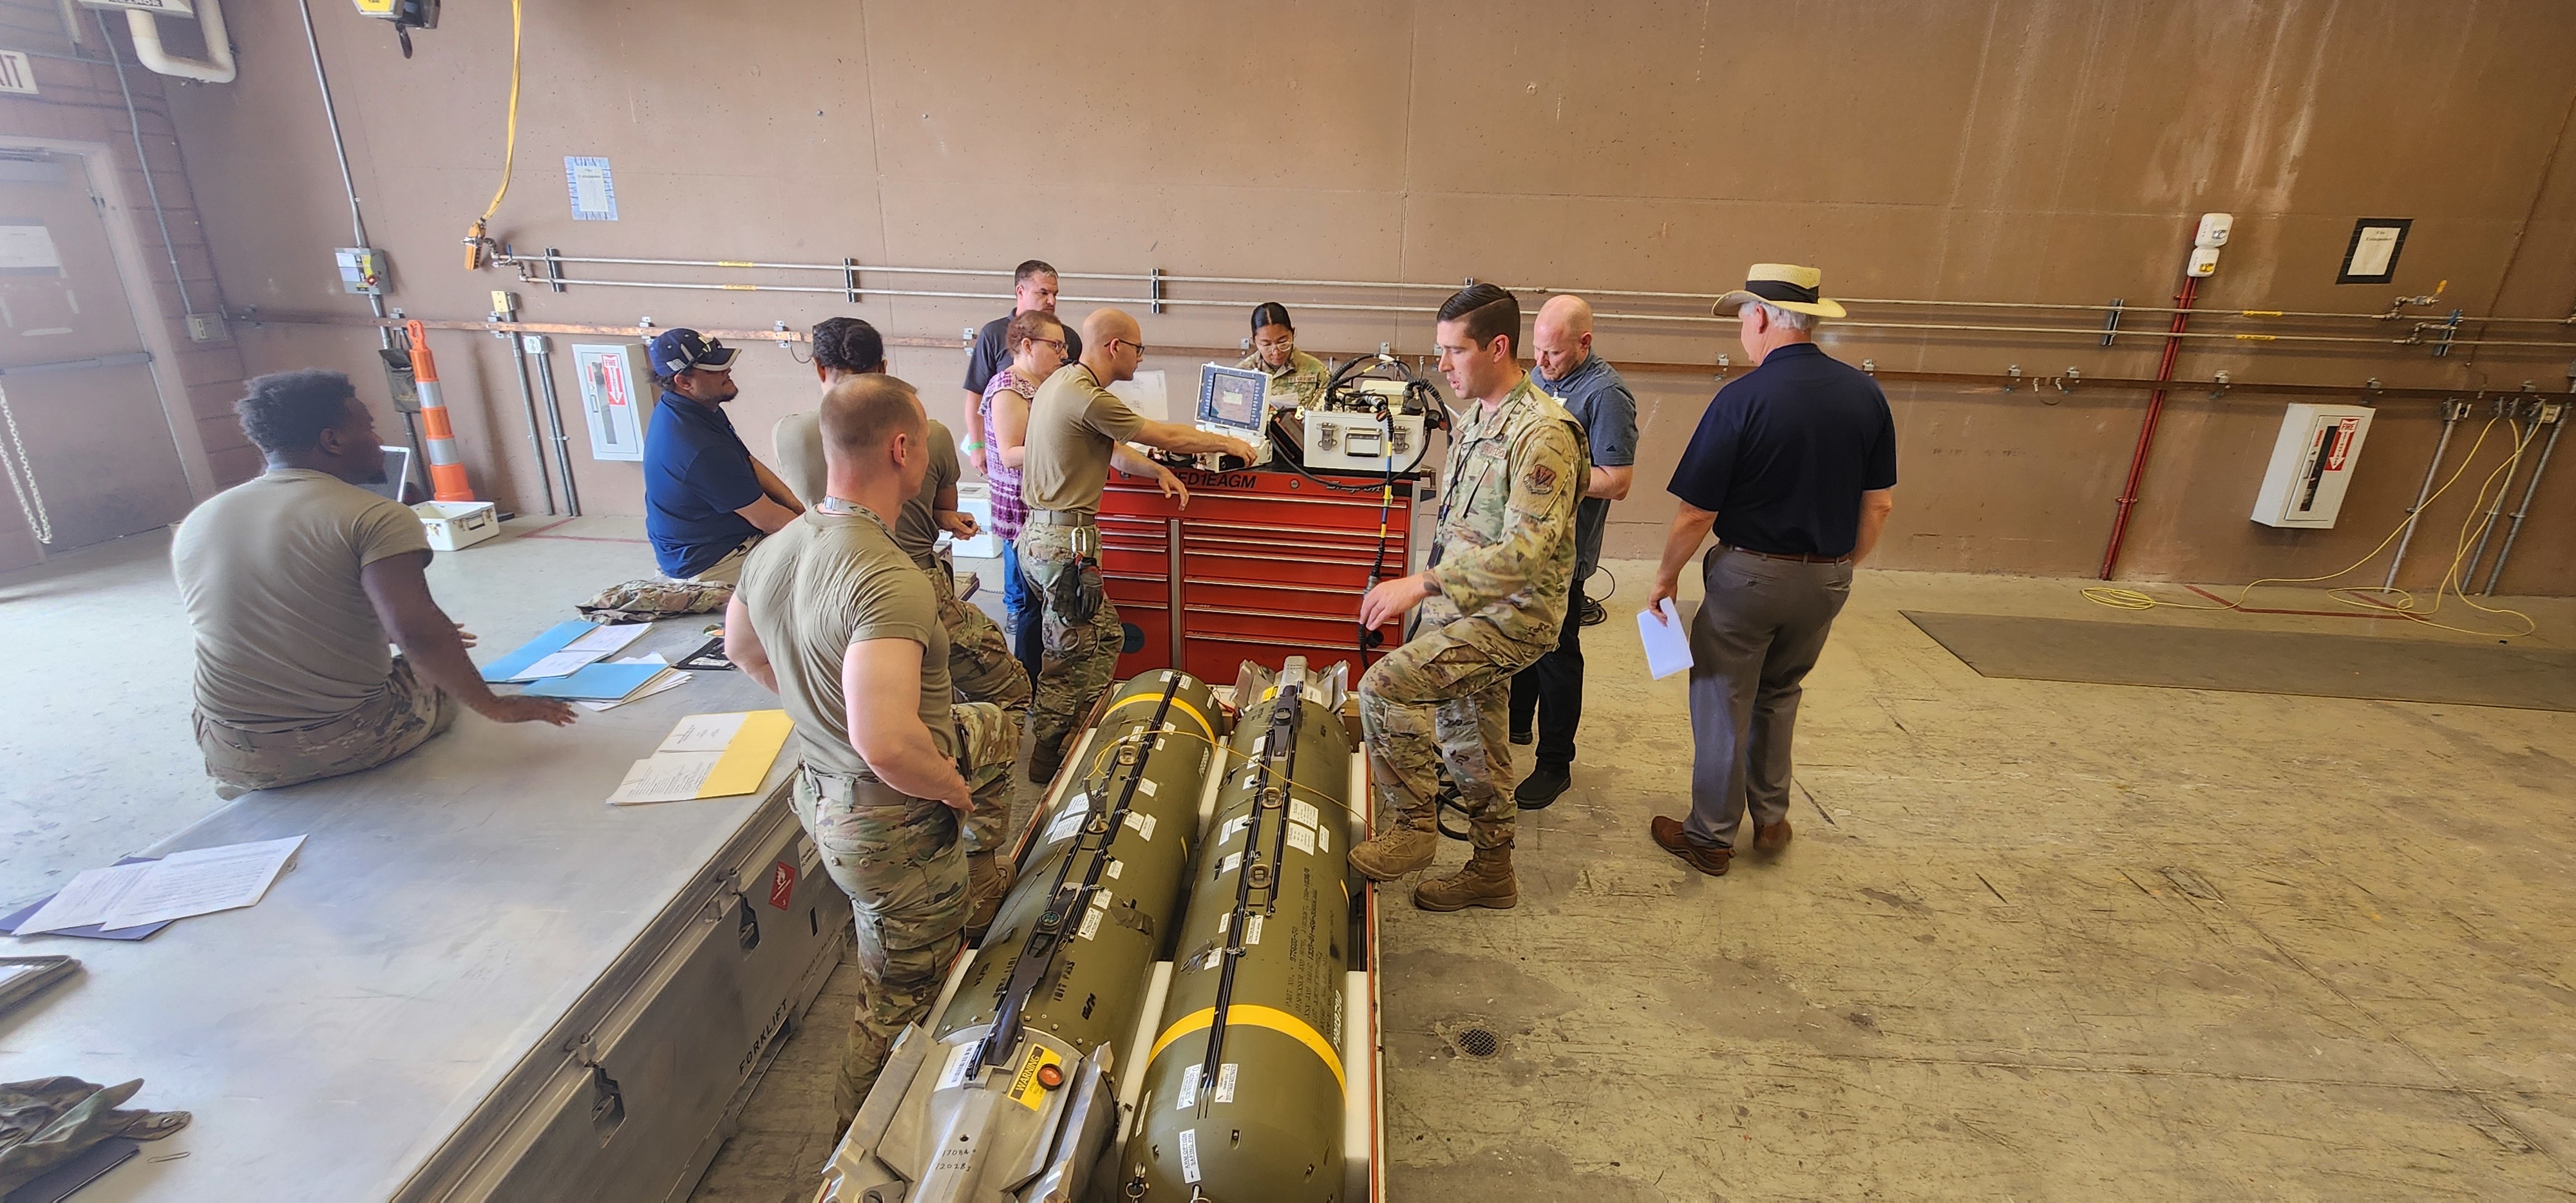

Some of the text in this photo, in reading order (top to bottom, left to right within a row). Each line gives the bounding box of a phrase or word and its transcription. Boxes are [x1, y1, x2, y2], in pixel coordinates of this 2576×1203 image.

[0, 54, 24, 88] IT
[2341, 422, 2356, 431] FIRE
[739, 998, 787, 1075] FORKLIFT
[1015, 1054, 1040, 1091] WARNING
